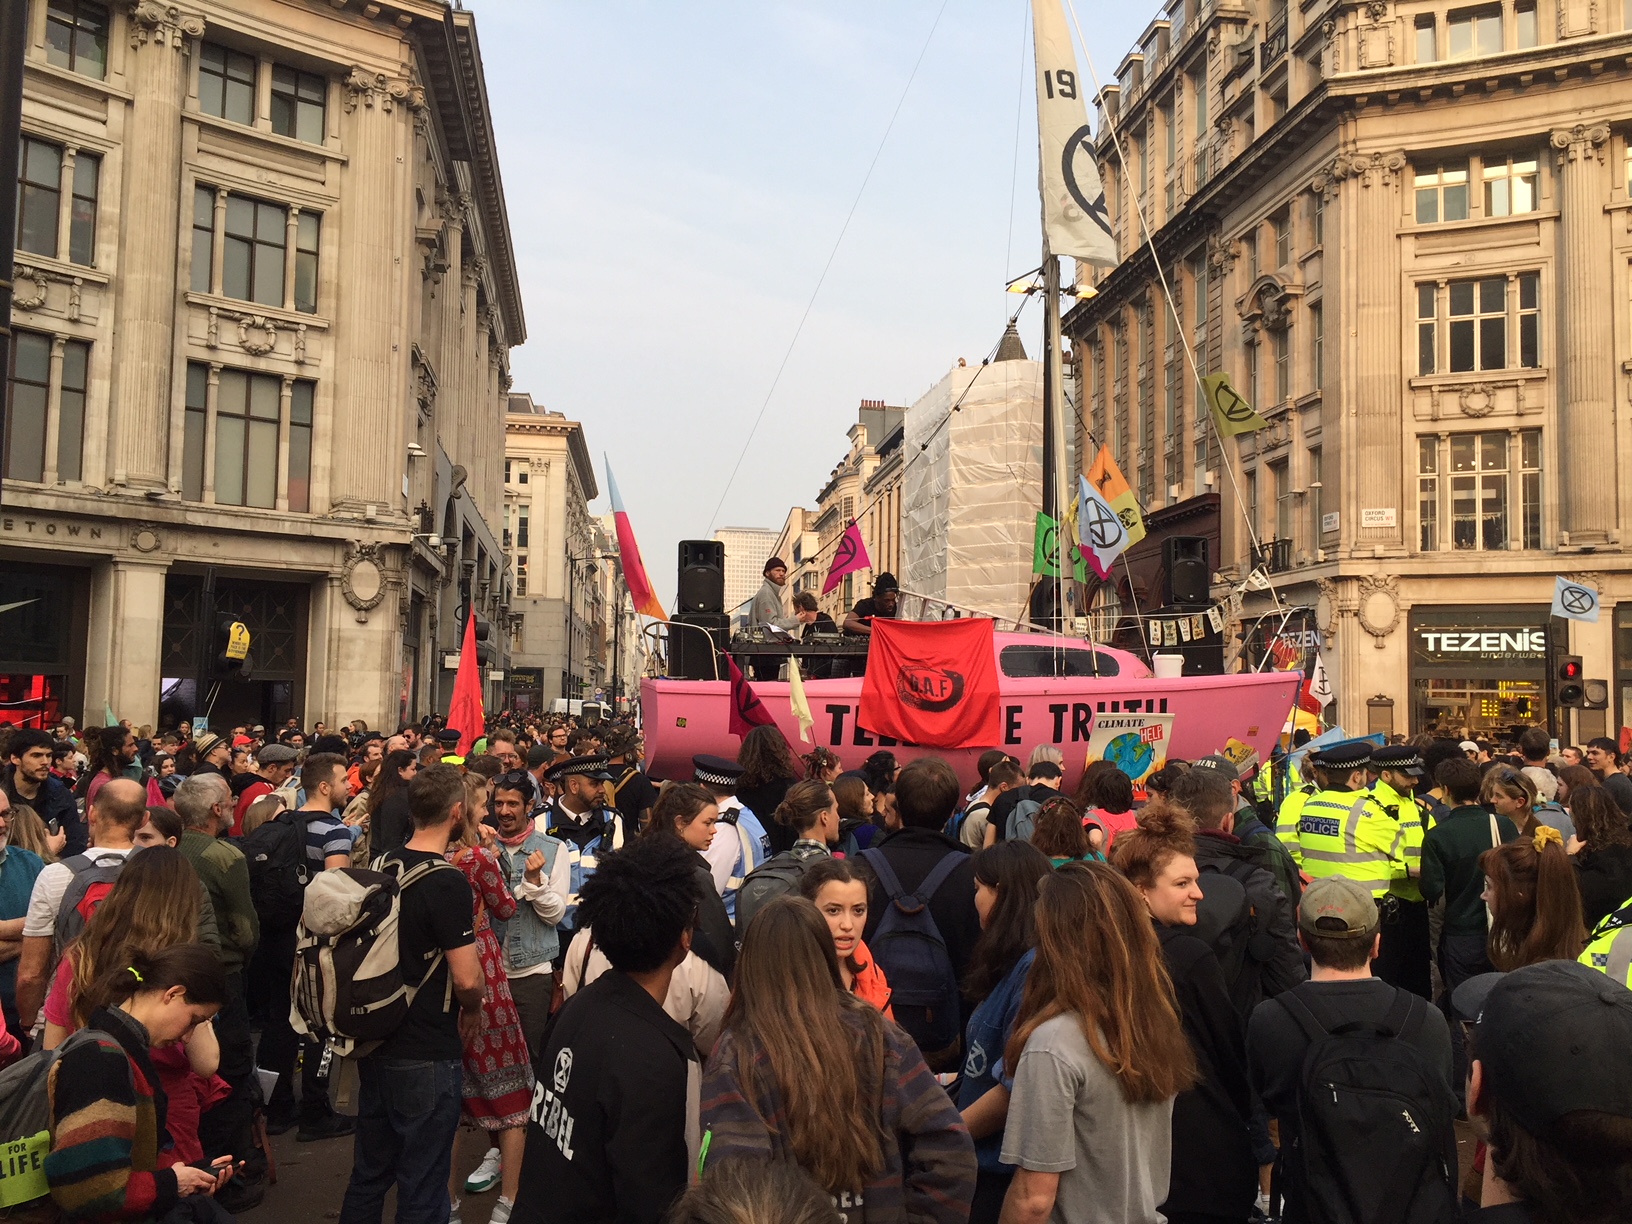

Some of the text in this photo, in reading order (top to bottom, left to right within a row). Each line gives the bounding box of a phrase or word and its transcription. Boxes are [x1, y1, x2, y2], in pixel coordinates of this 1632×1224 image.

[1044, 69, 1077, 100] 19
[3, 518, 102, 539] ETOWN
[1098, 719, 1145, 729] CLIMATE
[1140, 725, 1163, 743] HELP
[1301, 816, 1340, 826] ETROPOLITAN
[1301, 821, 1339, 836] POLICE
[528, 1080, 575, 1161] REBEL
[8, 1142, 27, 1155] FOR
[0, 1150, 41, 1180] LIFE
